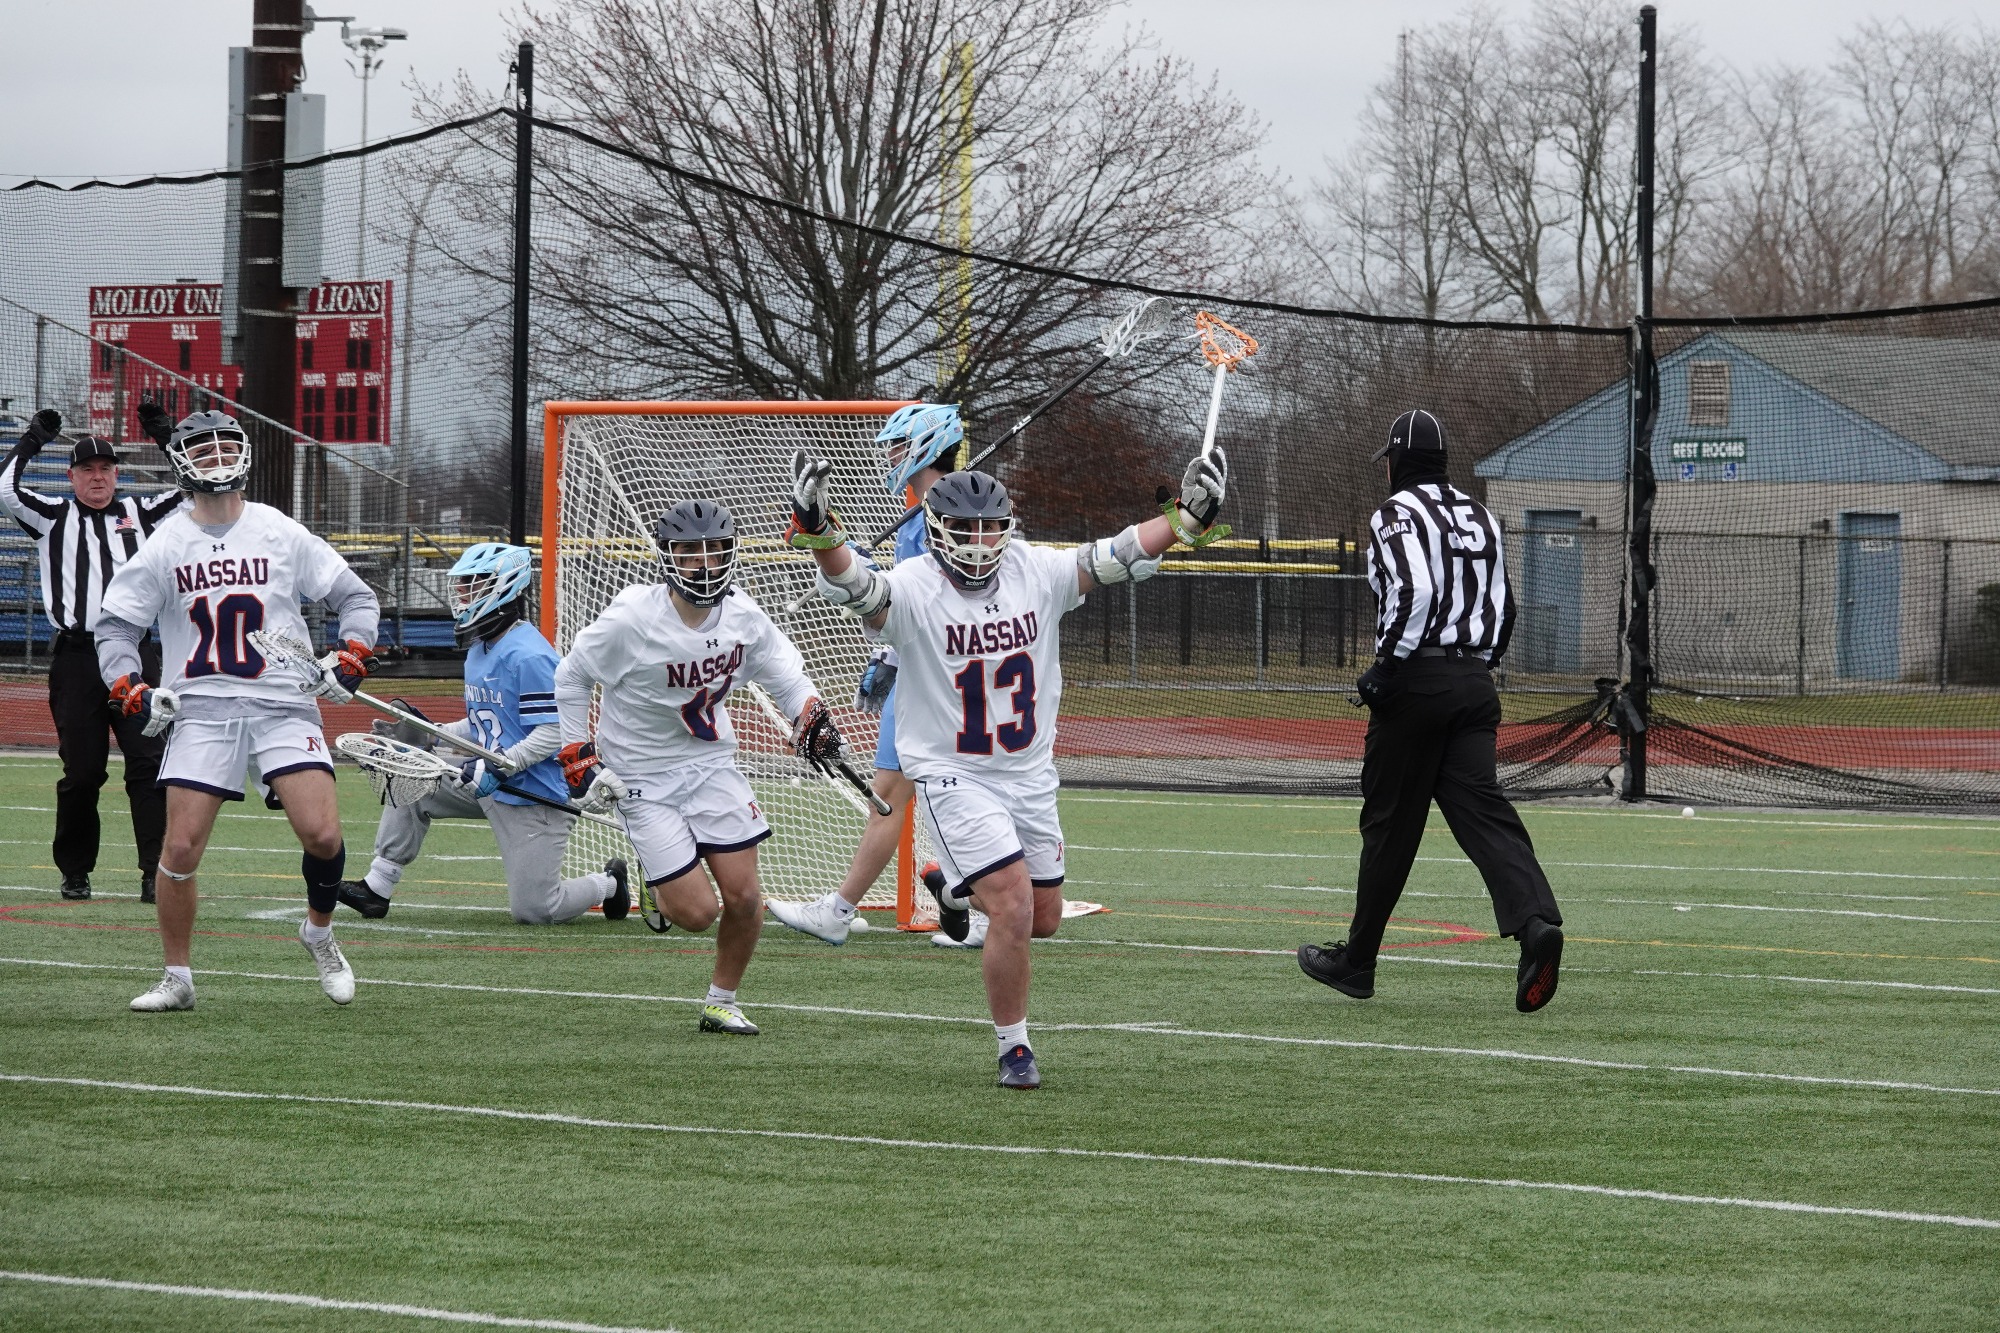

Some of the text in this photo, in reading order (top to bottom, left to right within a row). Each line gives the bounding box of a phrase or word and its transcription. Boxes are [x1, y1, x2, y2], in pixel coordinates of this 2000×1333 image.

[91, 289, 180, 315] MOLLOY
[316, 285, 381, 312] LIONS
[172, 324, 198, 340] BALL
[92, 391, 130, 411] GUET
[1673, 442, 1744, 458] REST ROOMS
[1379, 521, 1409, 541] NILOA
[176, 558, 269, 593] NASSAU
[185, 593, 266, 679] 10
[945, 611, 1038, 655] NASSAU
[666, 643, 745, 688] NASSAU
[955, 651, 1037, 755] 13
